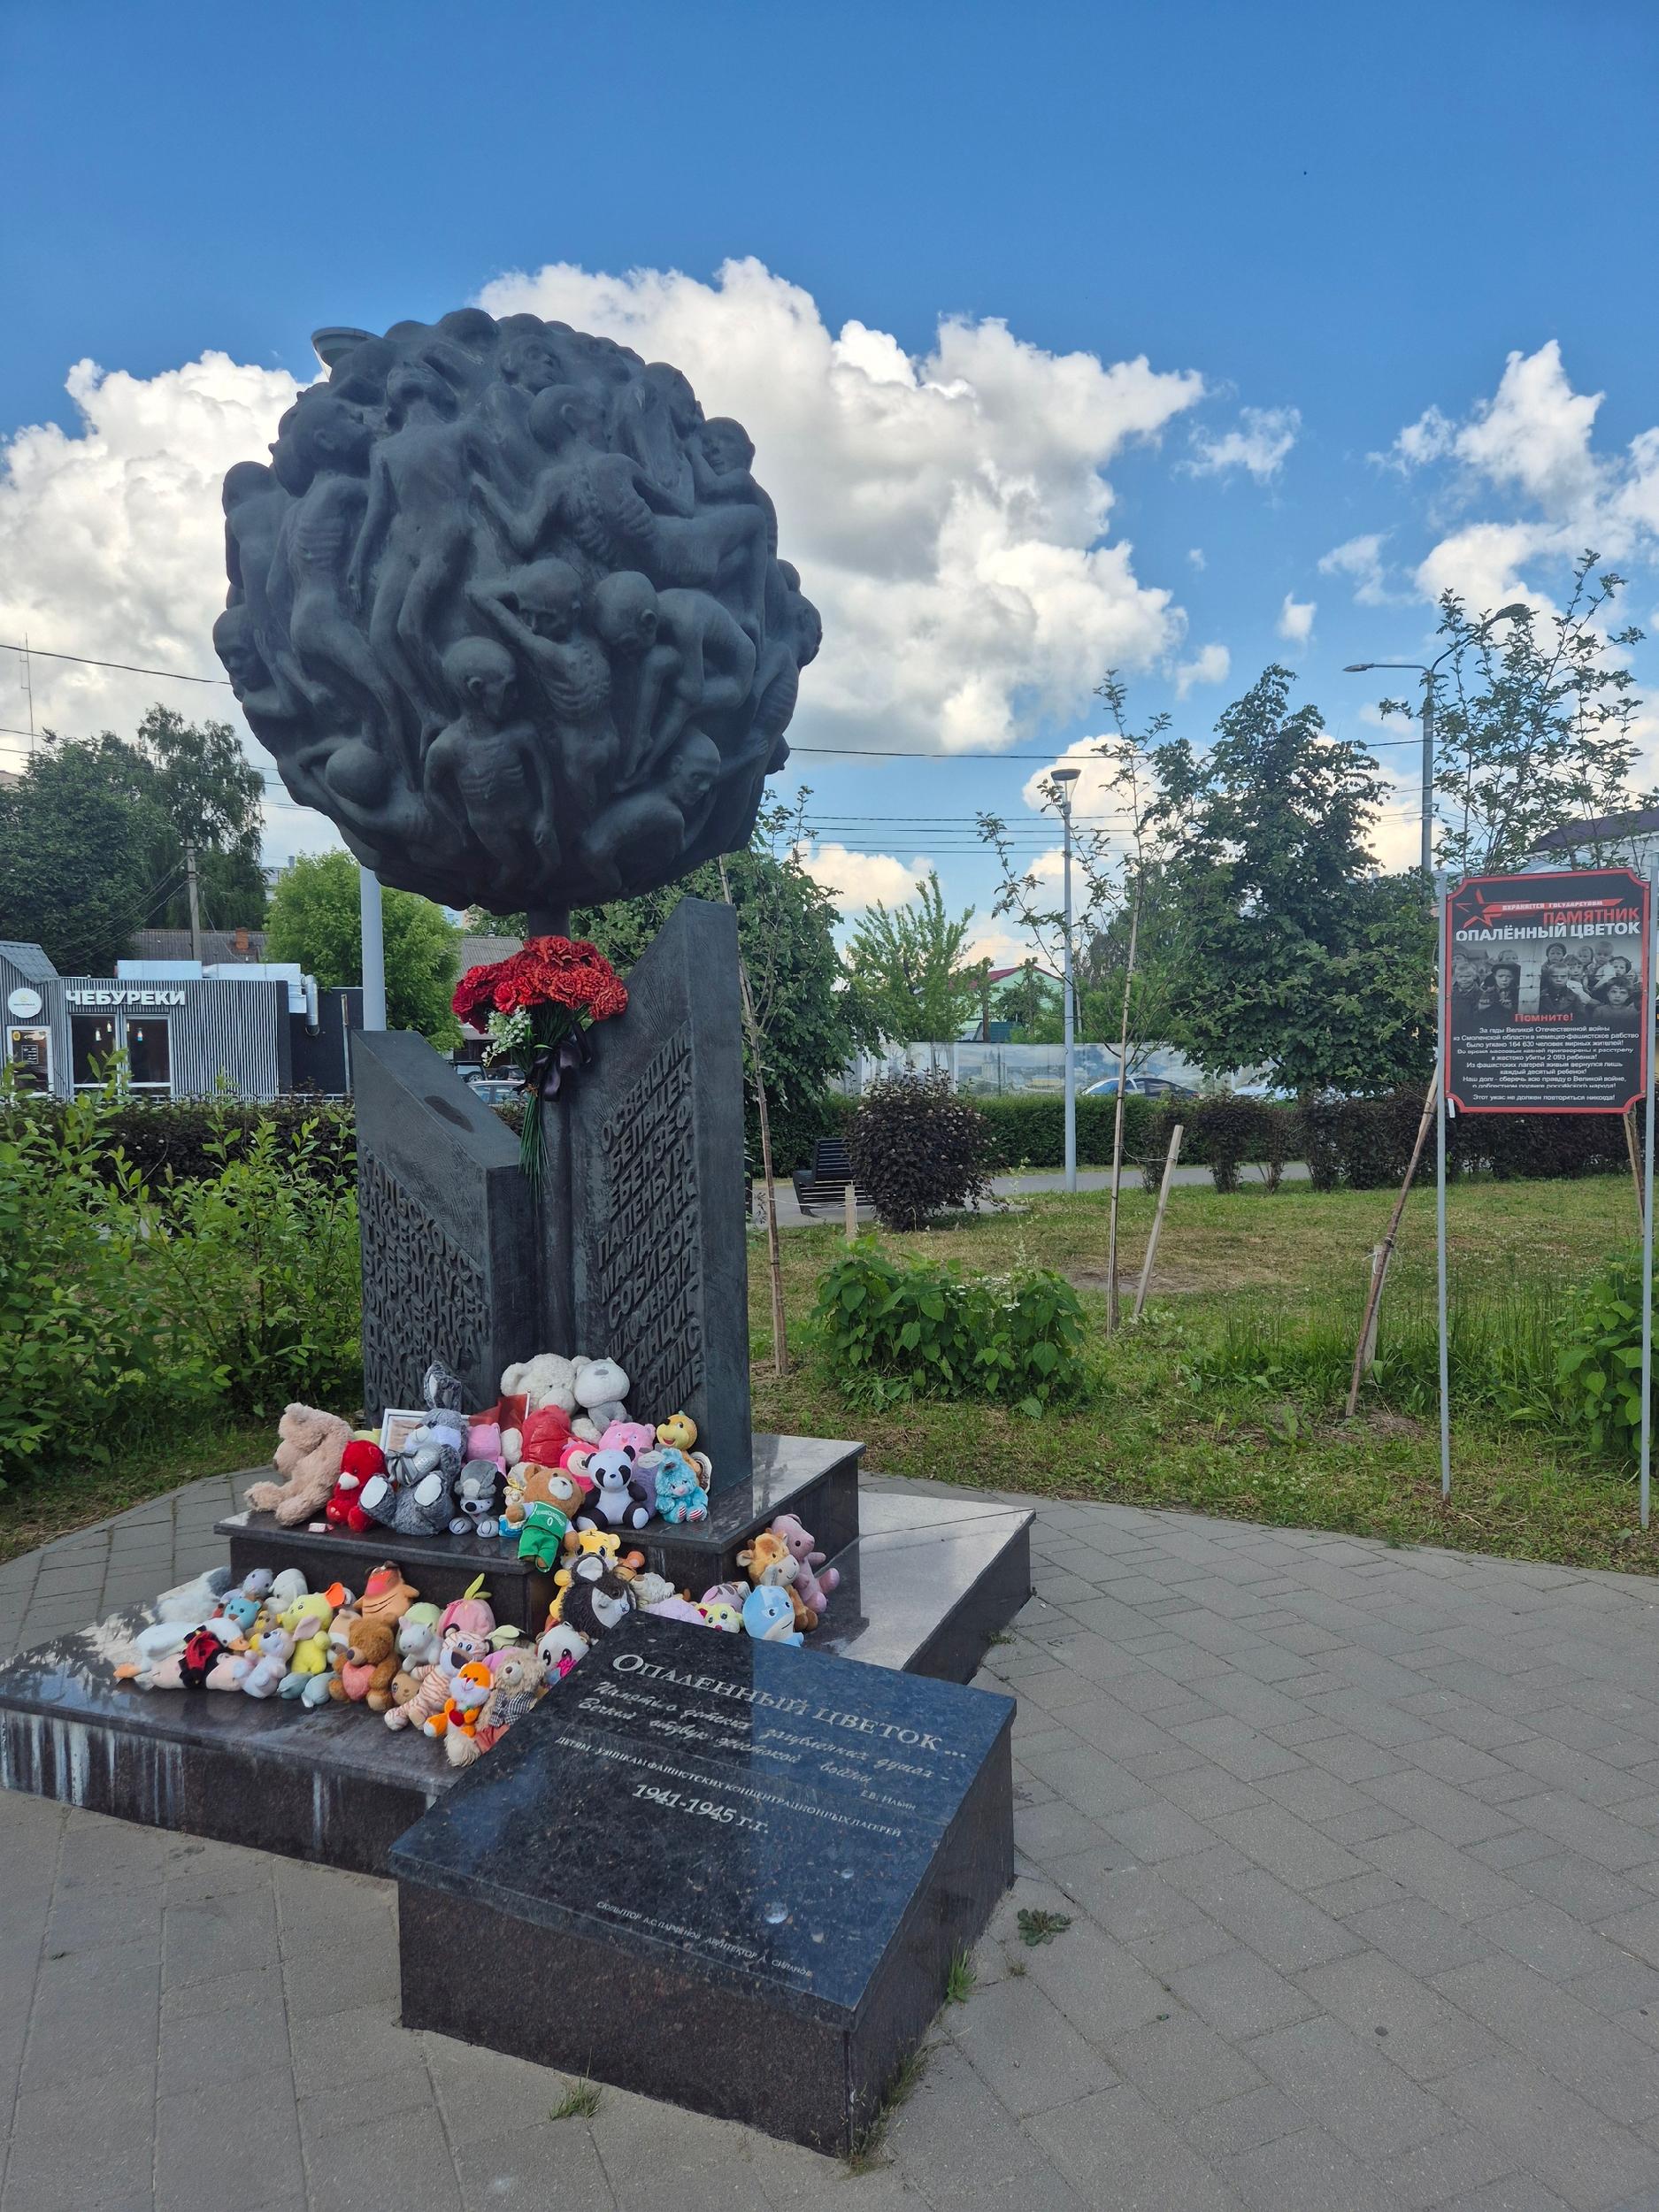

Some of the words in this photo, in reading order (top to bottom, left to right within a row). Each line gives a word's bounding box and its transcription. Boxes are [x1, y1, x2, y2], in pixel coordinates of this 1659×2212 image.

[1455, 922, 1567, 941] ОПАЛЁННЫЙ
[1571, 921, 1640, 940] ЦВЕТОК
[1543, 908, 1640, 926] ПАМЯТНИК
[65, 989, 186, 1006] ЧЕБУРЕКИ
[1515, 1012, 1573, 1023] Помните!
[603, 1020, 690, 1152] ОСВЕНЦИМ
[602, 1164, 697, 1304] МАЙДАНЕК
[609, 1204, 699, 1328] СОБИБОР
[812, 1708, 943, 1751] ЦВЕТОК
[873, 1757, 935, 1778] душах
[632, 1783, 736, 1824] 1941-1945
[725, 1782, 855, 1824] КОНЦЕНТРАЦИОННЫХ
[851, 1817, 902, 1838] ЛАГЕРЕЙ
